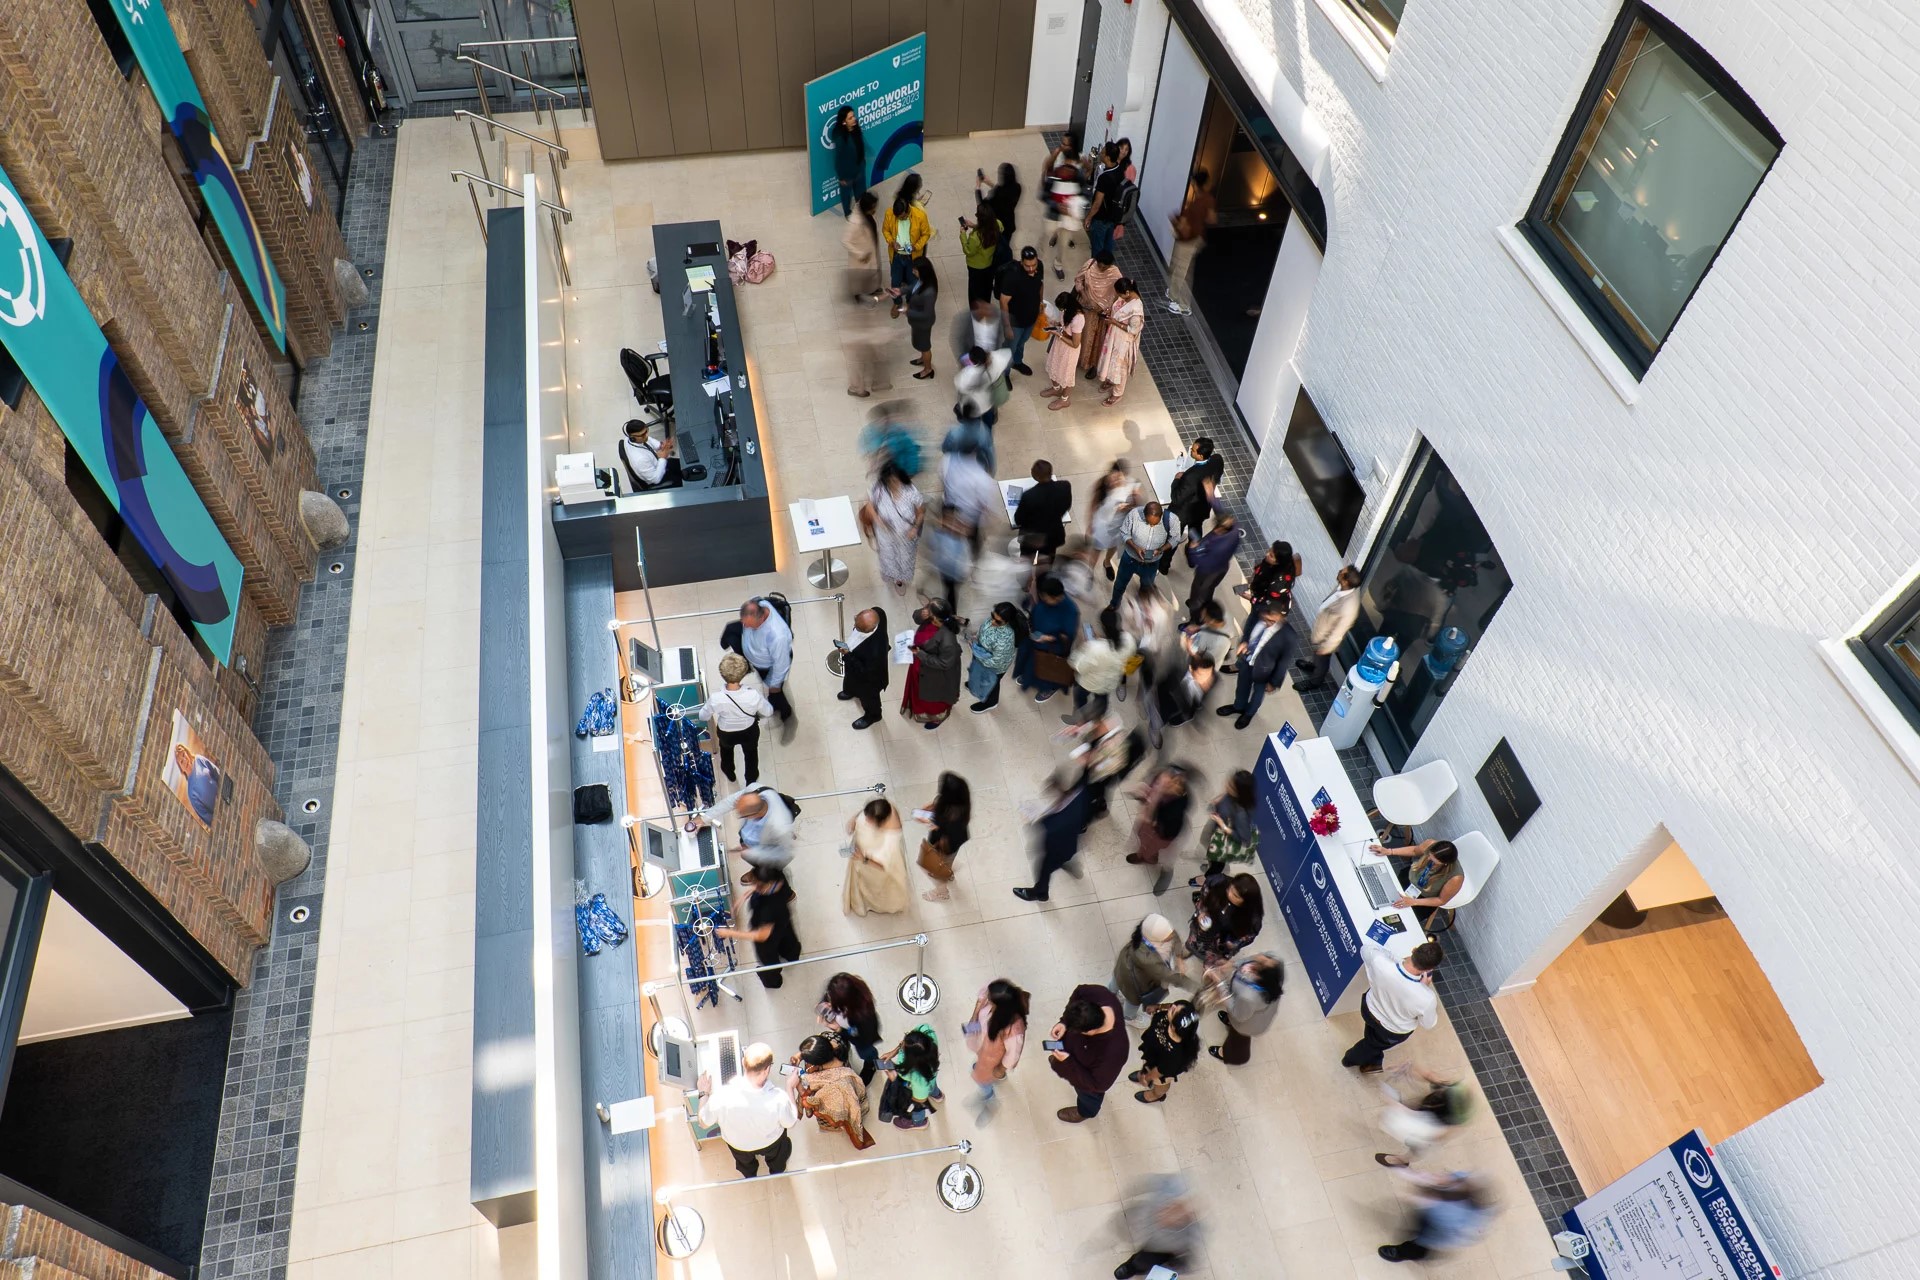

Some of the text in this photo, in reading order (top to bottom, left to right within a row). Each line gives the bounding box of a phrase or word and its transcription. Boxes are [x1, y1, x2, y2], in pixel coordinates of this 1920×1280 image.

[818, 80, 879, 114] WELCOME TO
[895, 104, 912, 116] LONDON
[1266, 795, 1286, 840] ENQUIRIES
[1300, 884, 1341, 978] QUERIES/PAYMENTS
[1308, 892, 1338, 959] REGISTRATION
[1656, 1177, 1676, 1214] LEVEL
[1667, 1170, 1705, 1238] EXHIBITION
[1717, 1222, 1728, 1238] JUNE
